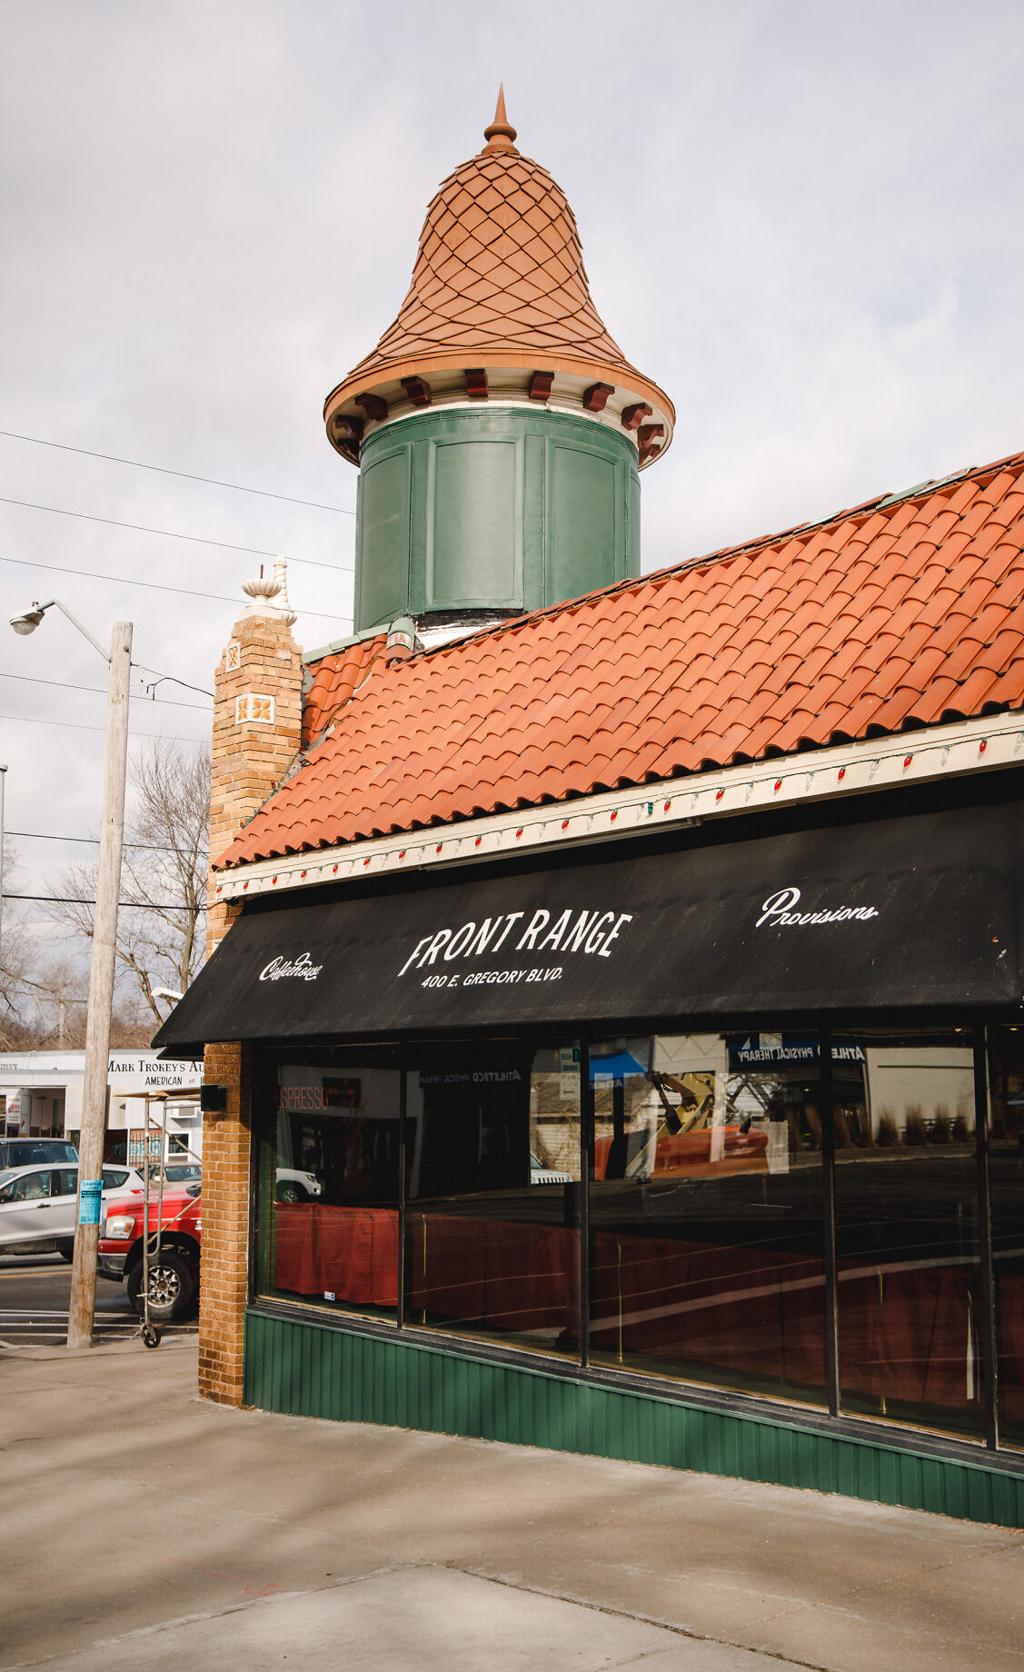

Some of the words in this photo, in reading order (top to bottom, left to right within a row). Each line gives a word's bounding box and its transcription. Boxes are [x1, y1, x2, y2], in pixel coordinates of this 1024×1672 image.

[756, 887, 879, 927] Provisions
[397, 911, 524, 976] FRONT
[515, 909, 633, 957] RANGE
[259, 952, 323, 981] Coffeehouse
[421, 975, 446, 988] 400
[447, 974, 460, 987] E.
[463, 969, 527, 986] GREGORY
[525, 967, 563, 982] BLVD.
[145, 1076, 183, 1086] AMERICAN
